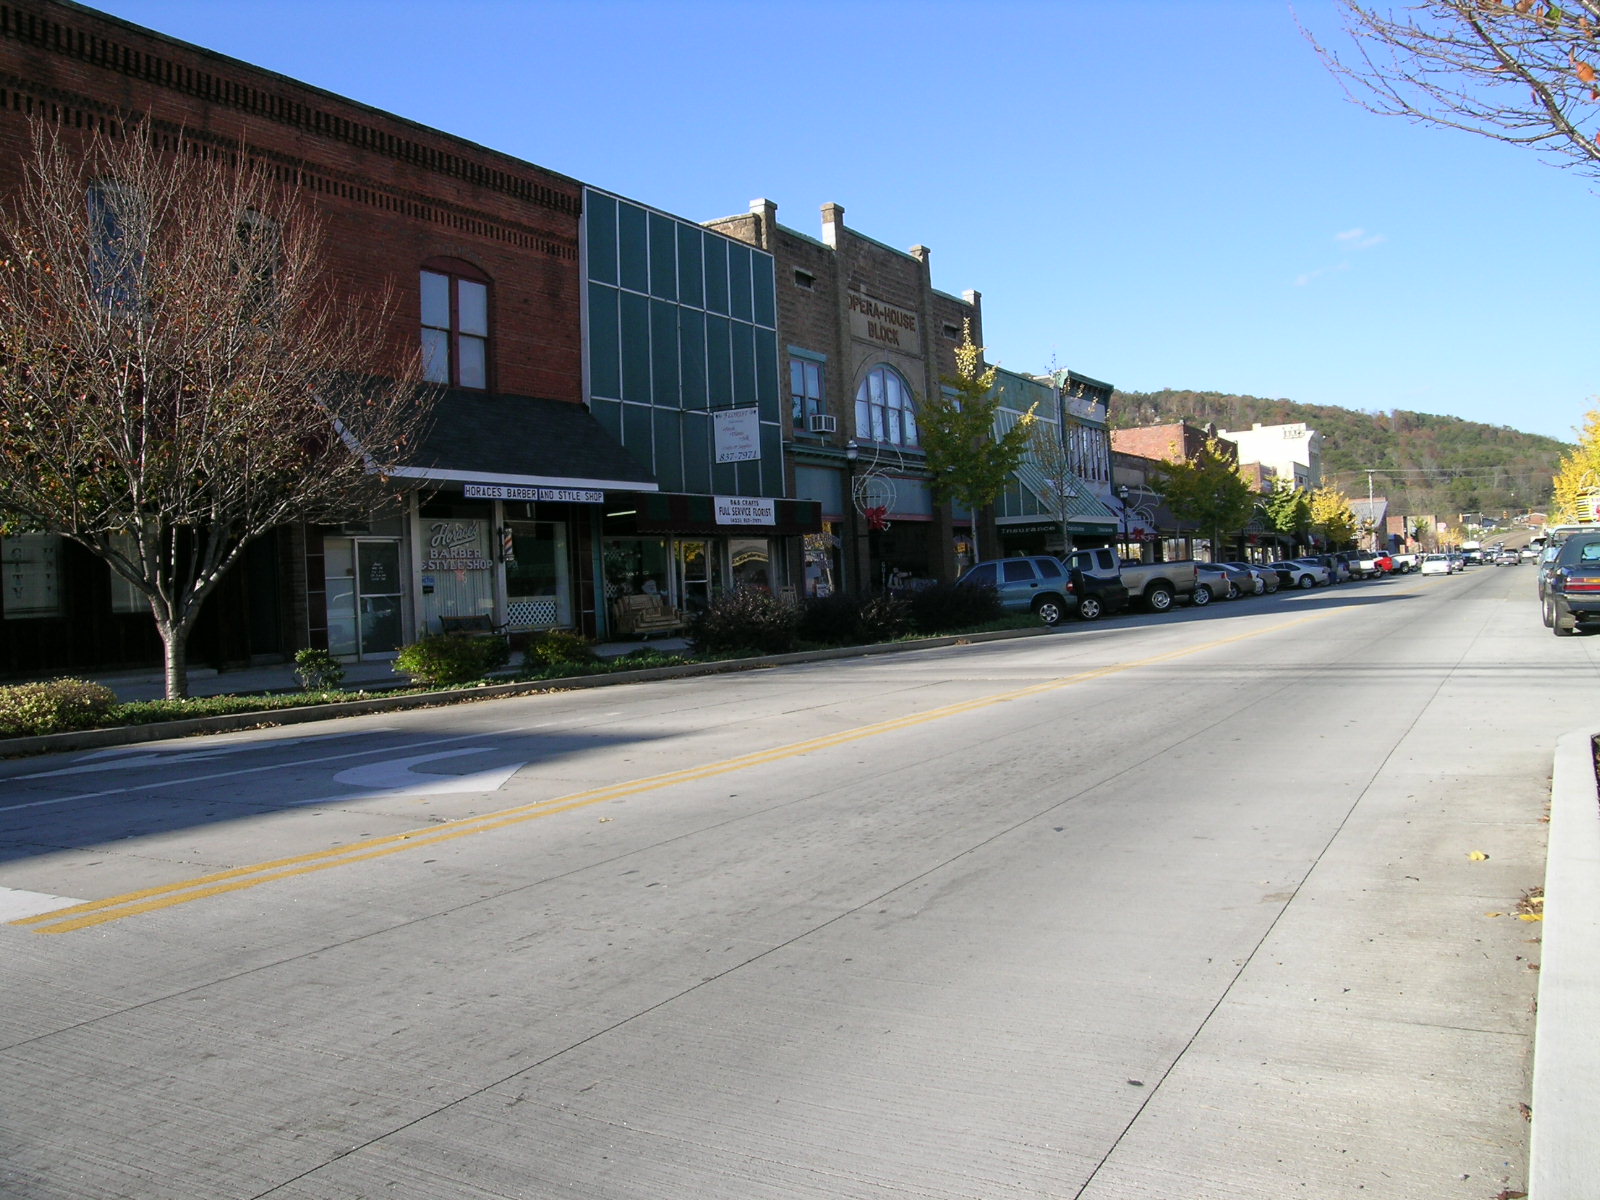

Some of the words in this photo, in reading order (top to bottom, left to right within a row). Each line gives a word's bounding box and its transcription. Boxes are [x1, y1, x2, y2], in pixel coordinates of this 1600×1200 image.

[867, 320, 900, 346] BLOCK
[719, 450, 757, 462] 837-7971
[465, 486, 502, 497] HORACES
[507, 488, 537, 499] BARBER
[540, 490, 554, 500] AND
[558, 490, 581, 501] STYLE
[585, 491, 602, 502] SHOP
[742, 499, 759, 507] CRAFTS
[719, 506, 731, 516] FULL
[732, 506, 751, 516] SERVICE
[752, 507, 771, 517] FLORIST
[430, 548, 481, 559] BARBER
[428, 559, 465, 570] STYLE
[466, 559, 493, 570] SHOP
